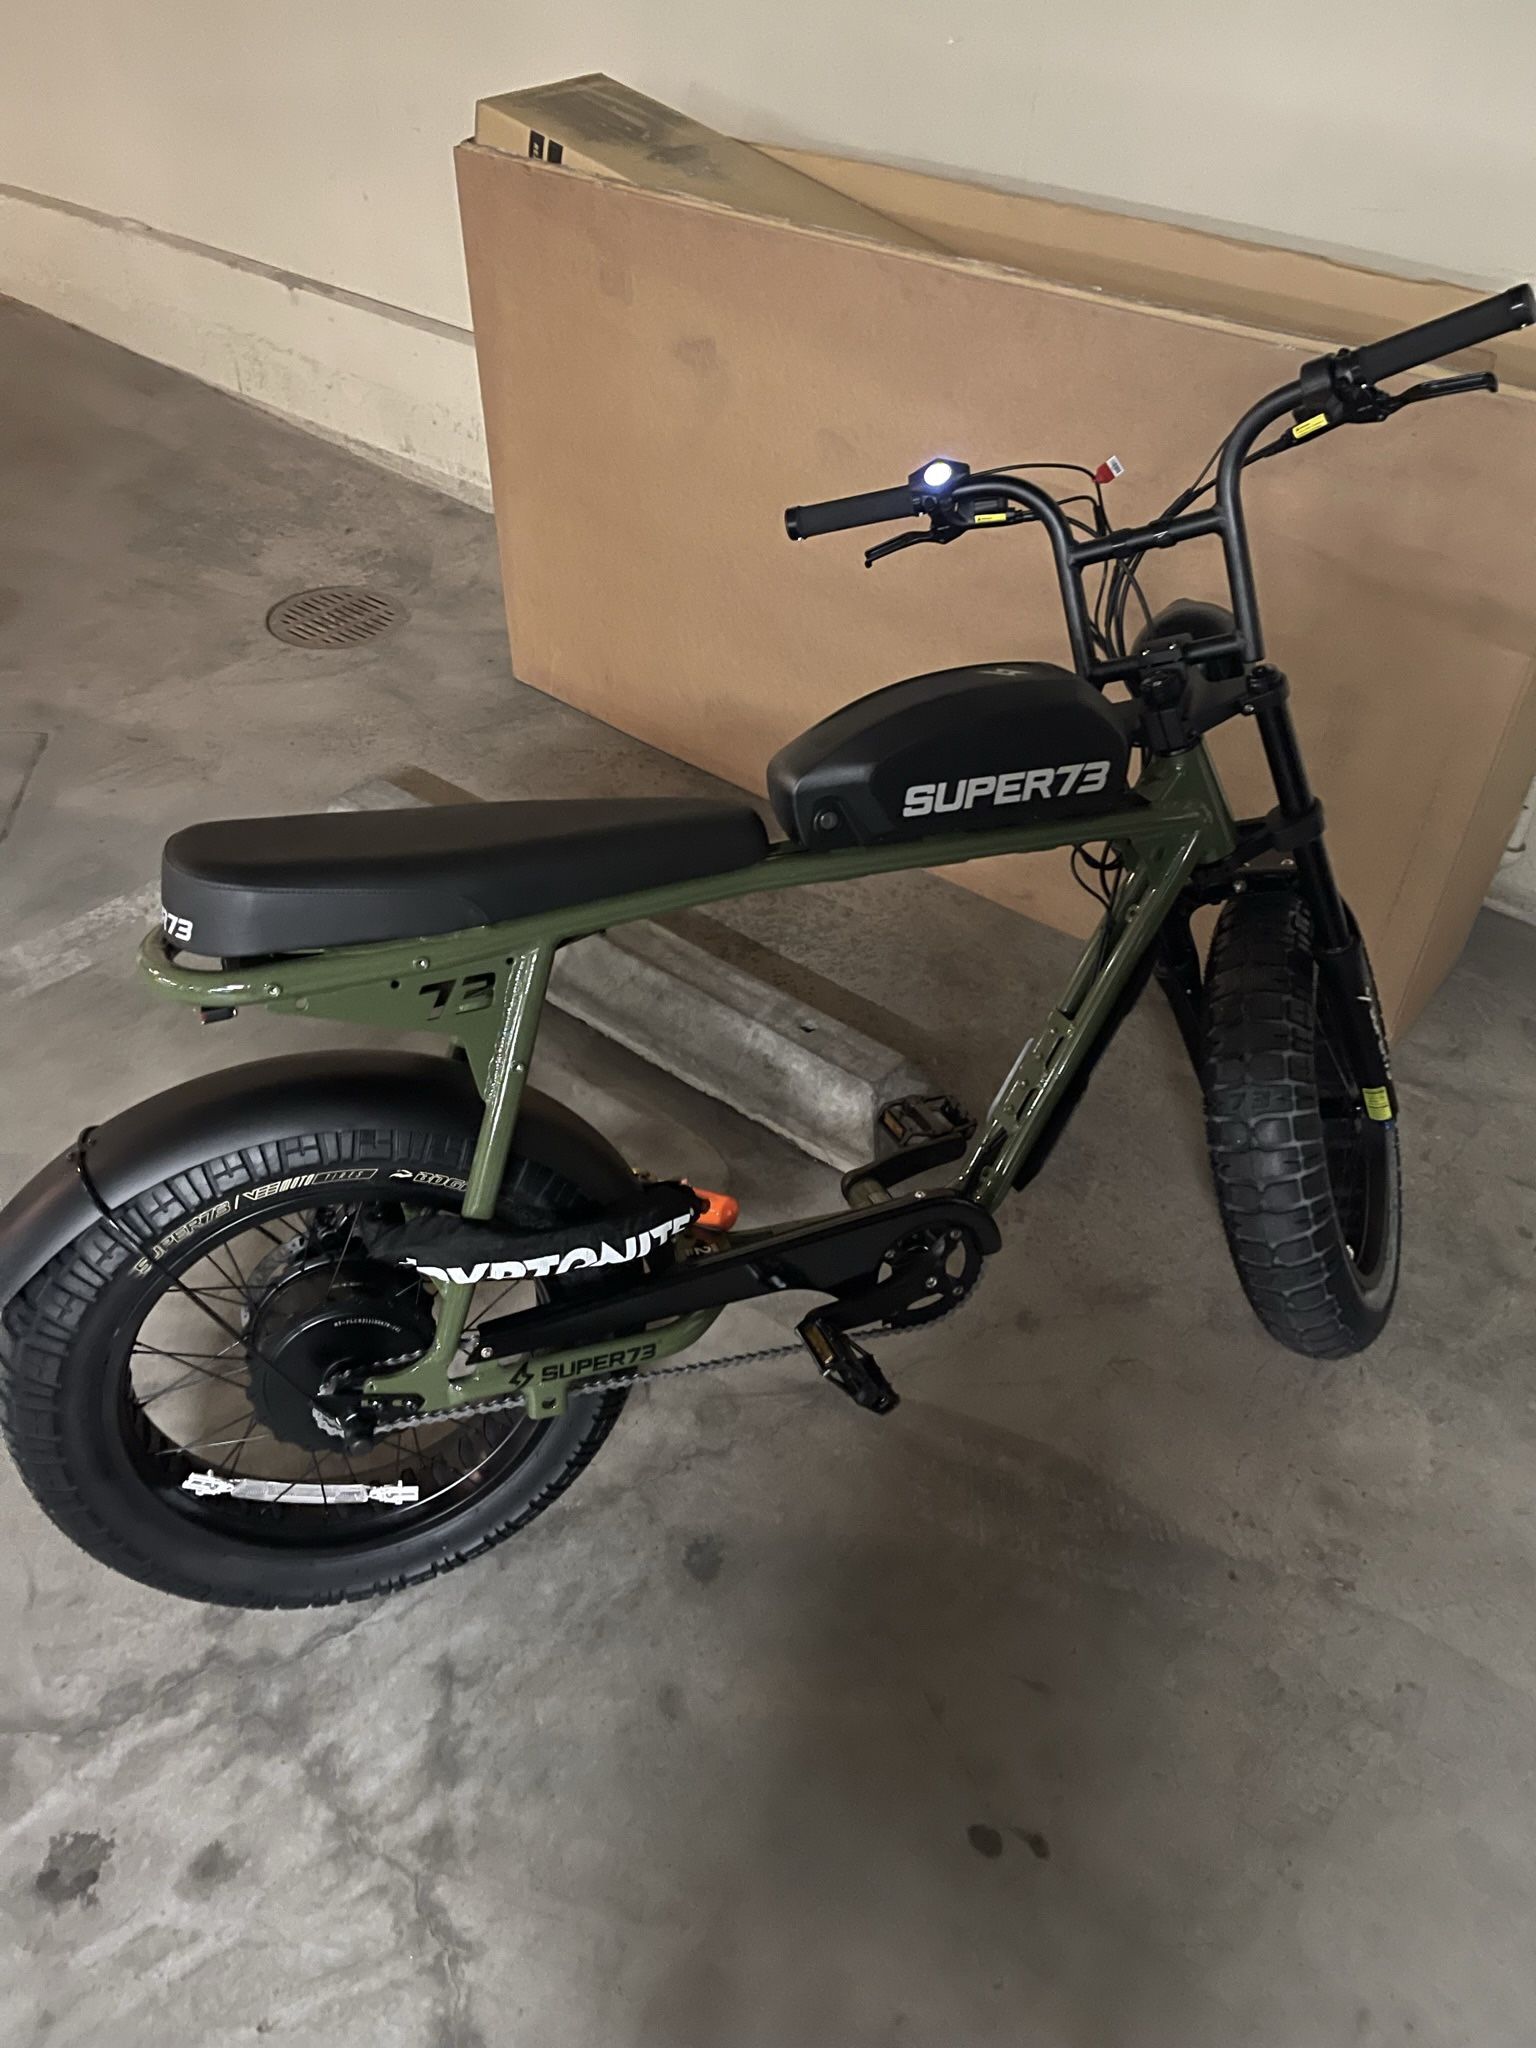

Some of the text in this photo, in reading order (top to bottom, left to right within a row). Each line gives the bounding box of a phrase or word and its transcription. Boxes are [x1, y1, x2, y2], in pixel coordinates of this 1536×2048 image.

[902, 761, 1111, 817] SUPER73
[419, 972, 496, 1021] 73
[541, 1344, 657, 1382] SUPER73
